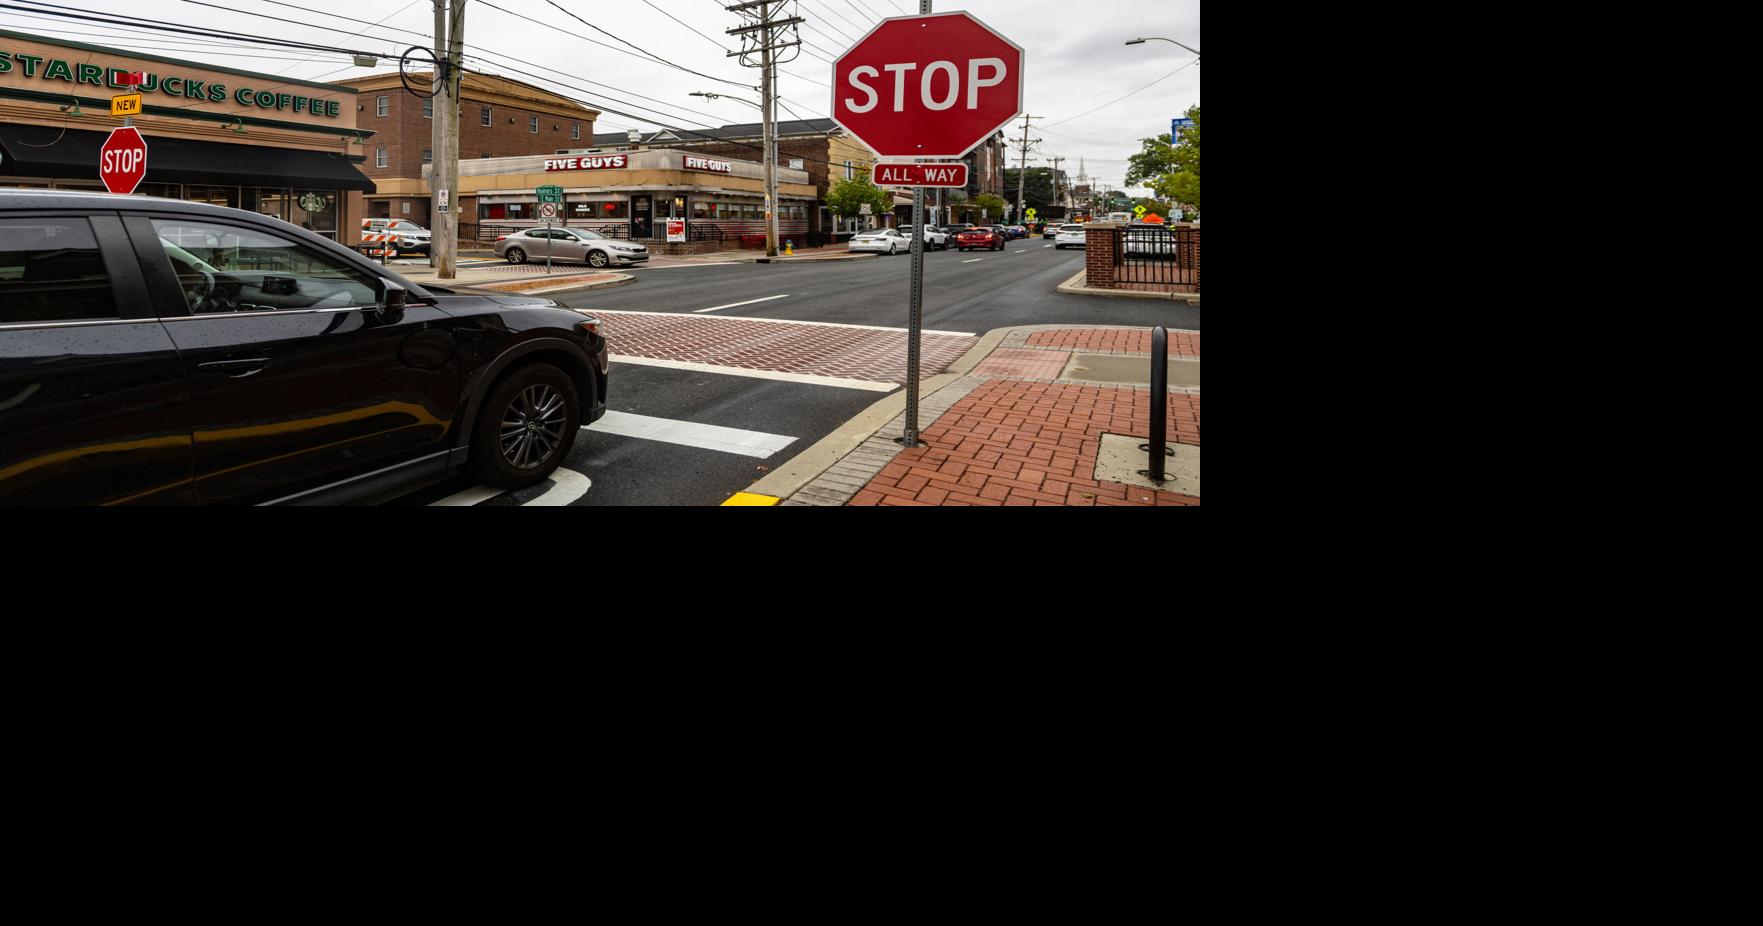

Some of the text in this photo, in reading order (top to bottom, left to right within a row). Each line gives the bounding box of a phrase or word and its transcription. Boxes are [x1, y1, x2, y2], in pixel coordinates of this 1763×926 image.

[844, 57, 1007, 114] STOP
[116, 99, 137, 111] NEW
[235, 87, 340, 117] COFFEE
[103, 148, 143, 174] STOP
[544, 156, 625, 170] FIVE GUYS
[687, 157, 732, 172] FIVE GUYS
[881, 167, 958, 182] ALL WAY
